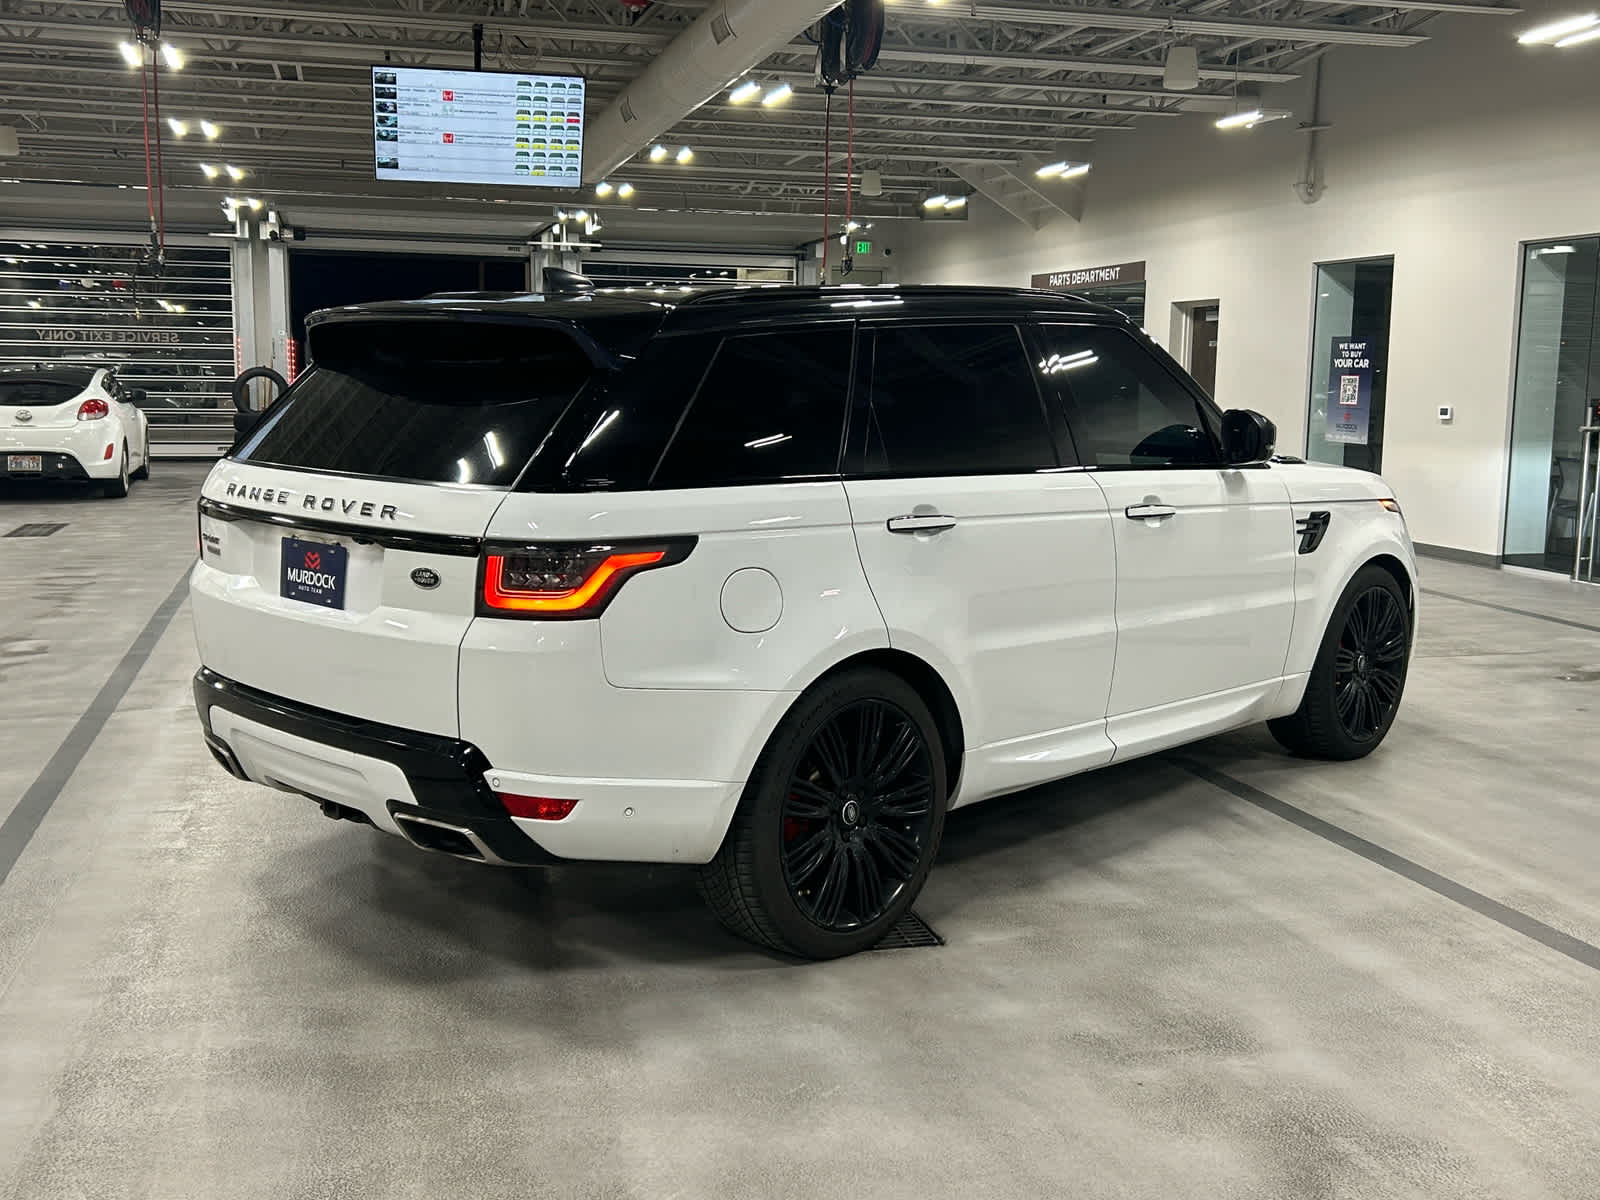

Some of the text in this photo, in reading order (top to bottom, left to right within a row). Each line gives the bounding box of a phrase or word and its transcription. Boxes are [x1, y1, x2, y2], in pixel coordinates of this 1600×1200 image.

[857, 241, 870, 254] EXIT
[1049, 267, 1120, 287] PARTS DEPARTMENT
[1339, 342, 1367, 350] WE WANT
[1342, 350, 1363, 358] TO BUY
[1333, 358, 1369, 368] YOUR CAR
[226, 482, 399, 521] RANGE ROVER
[287, 567, 336, 591] MURDOCK
